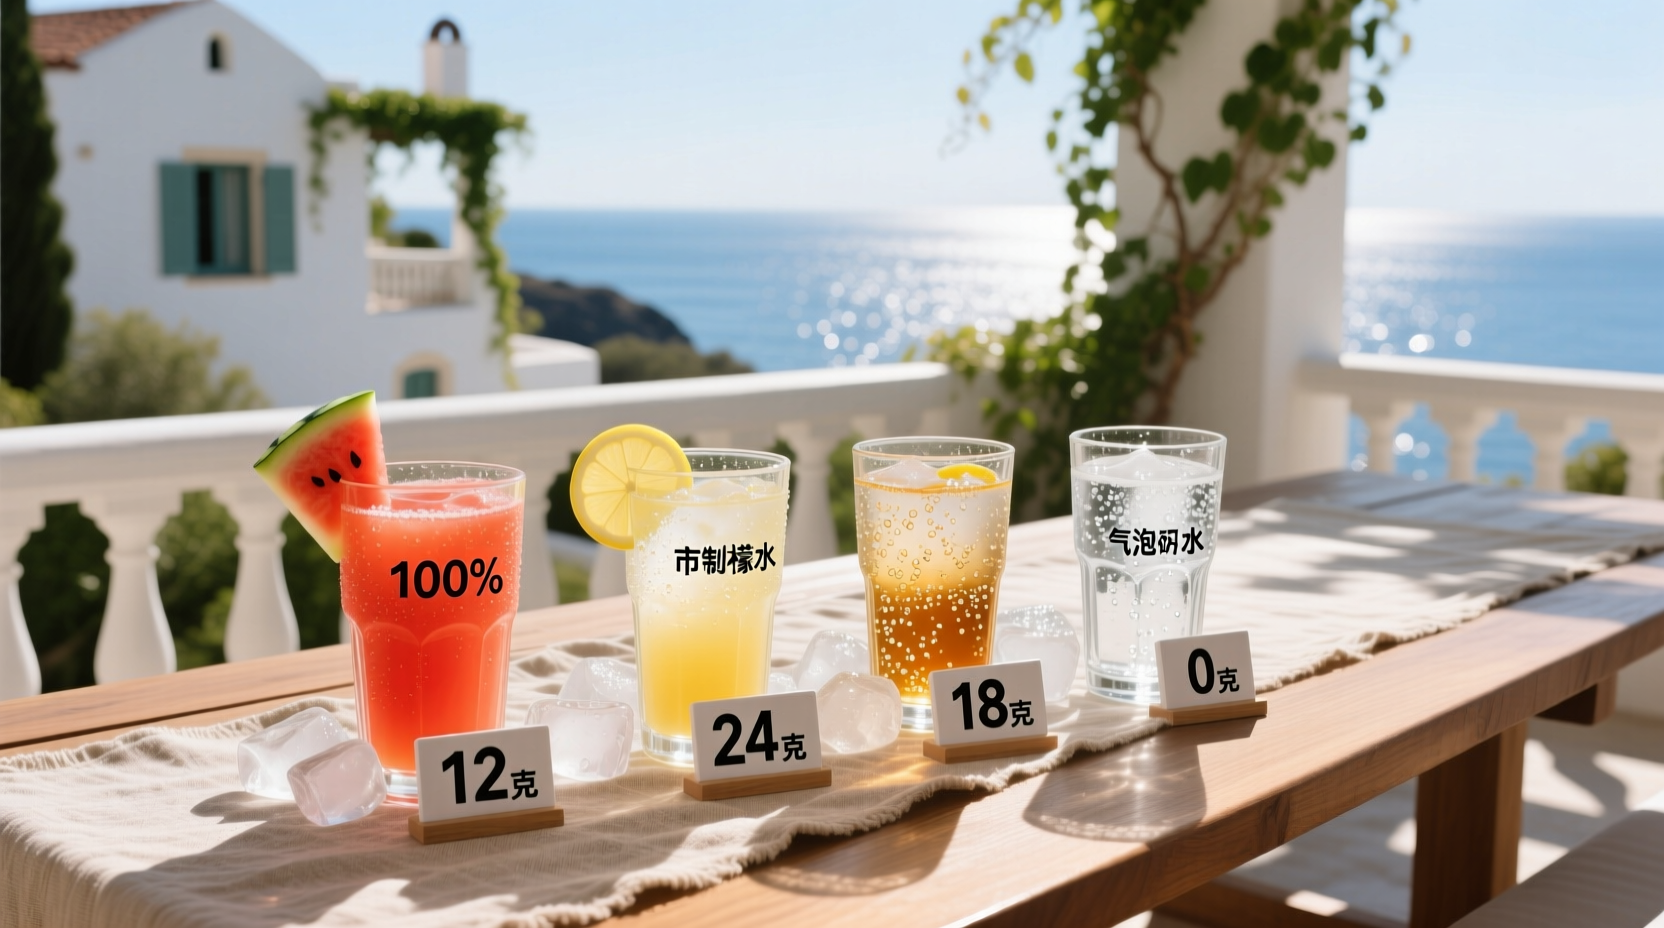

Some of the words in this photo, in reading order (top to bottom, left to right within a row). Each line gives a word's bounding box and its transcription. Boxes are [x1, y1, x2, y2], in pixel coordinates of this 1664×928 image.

[391, 557, 503, 598] 100%
[1188, 648, 1240, 694] 0克
[952, 679, 1034, 730] 18克
[713, 710, 807, 766] 24克
[442, 746, 538, 804] 12克
